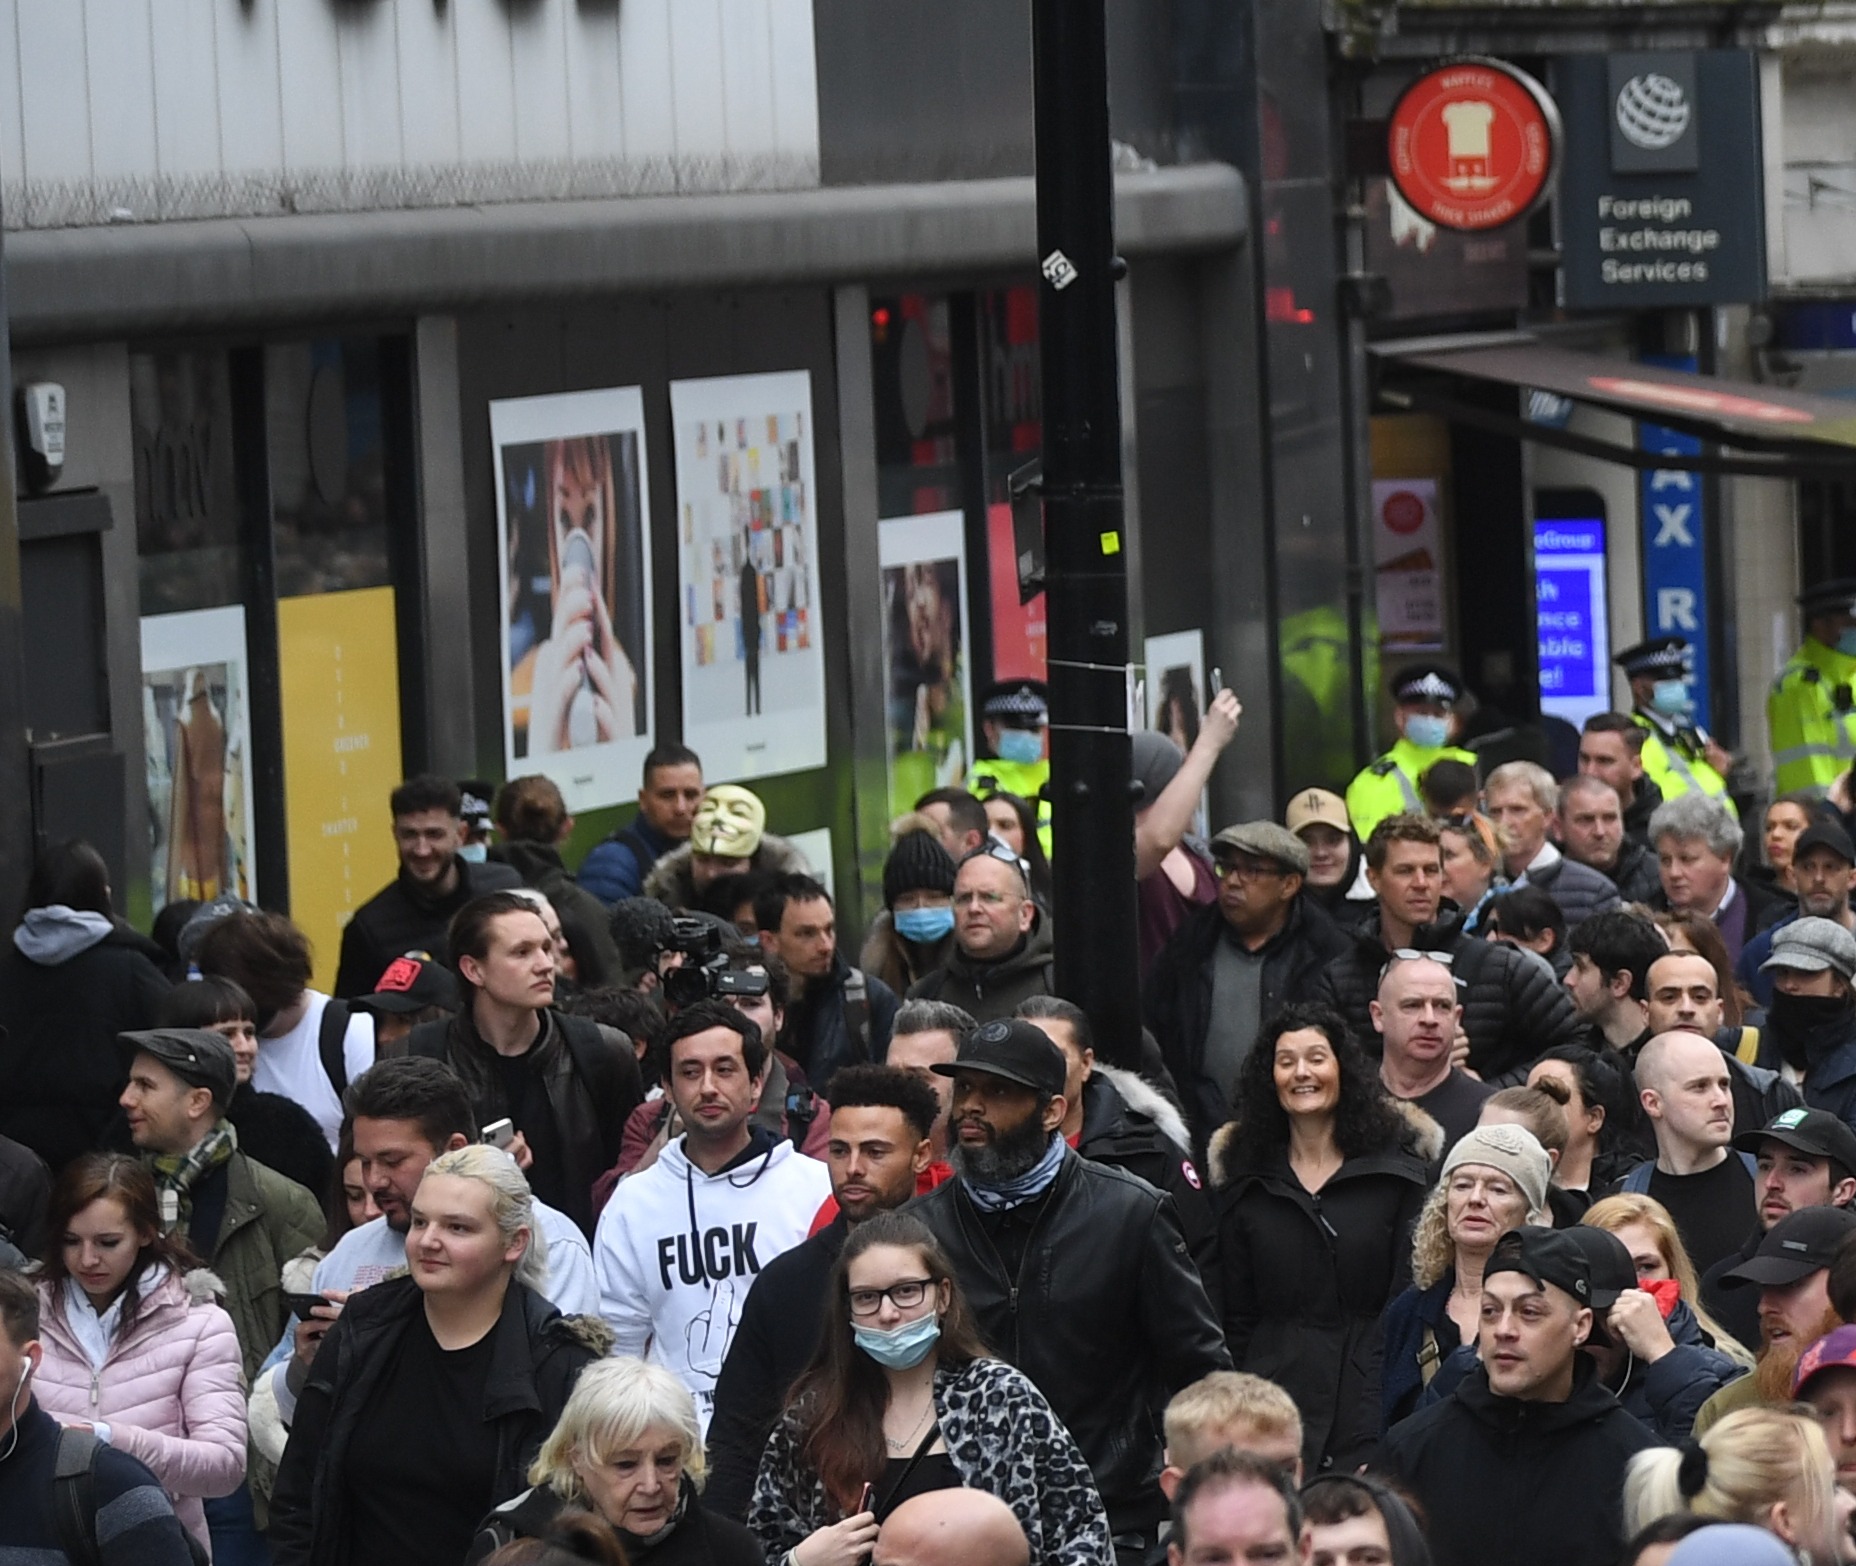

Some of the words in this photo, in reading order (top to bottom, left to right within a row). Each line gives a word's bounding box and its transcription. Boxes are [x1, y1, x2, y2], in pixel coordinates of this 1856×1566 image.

[1598, 195, 1692, 223] Foreign
[1599, 227, 1721, 255] Exchange
[1601, 258, 1710, 285] Services
[657, 1221, 761, 1291] FUCK
